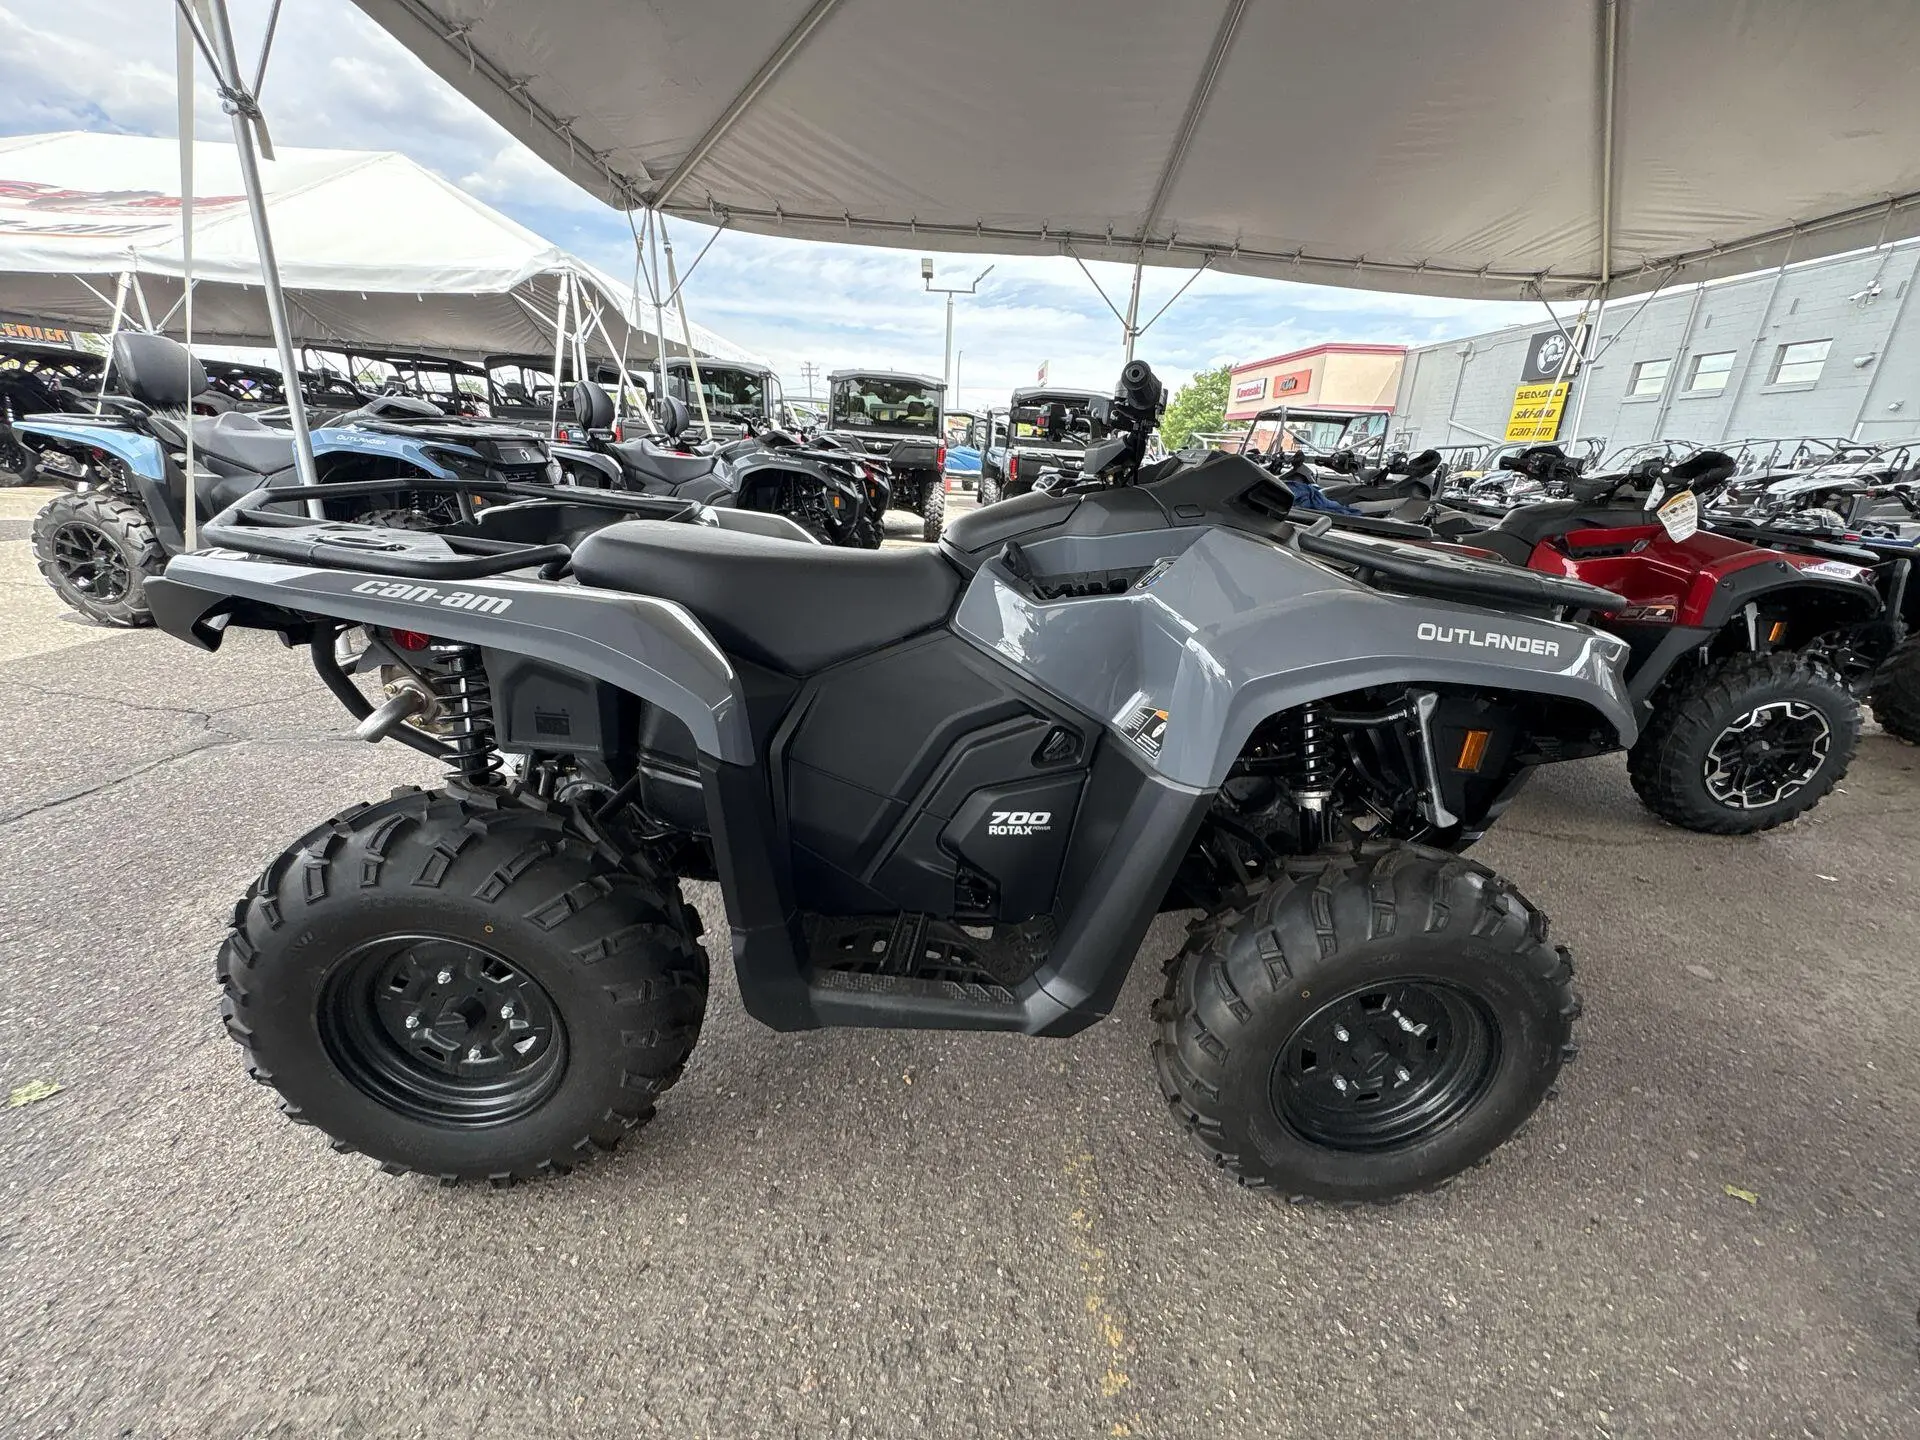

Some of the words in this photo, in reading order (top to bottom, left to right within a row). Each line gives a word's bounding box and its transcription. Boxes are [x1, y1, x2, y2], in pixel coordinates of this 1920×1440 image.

[336, 434, 386, 445] OUTLANDER
[1800, 562, 1851, 576] OUTLANDER
[351, 580, 513, 614] can-am
[1417, 623, 1560, 657] OUTLANDER
[989, 811, 1051, 825] 700
[988, 825, 1032, 835] ROTAX
